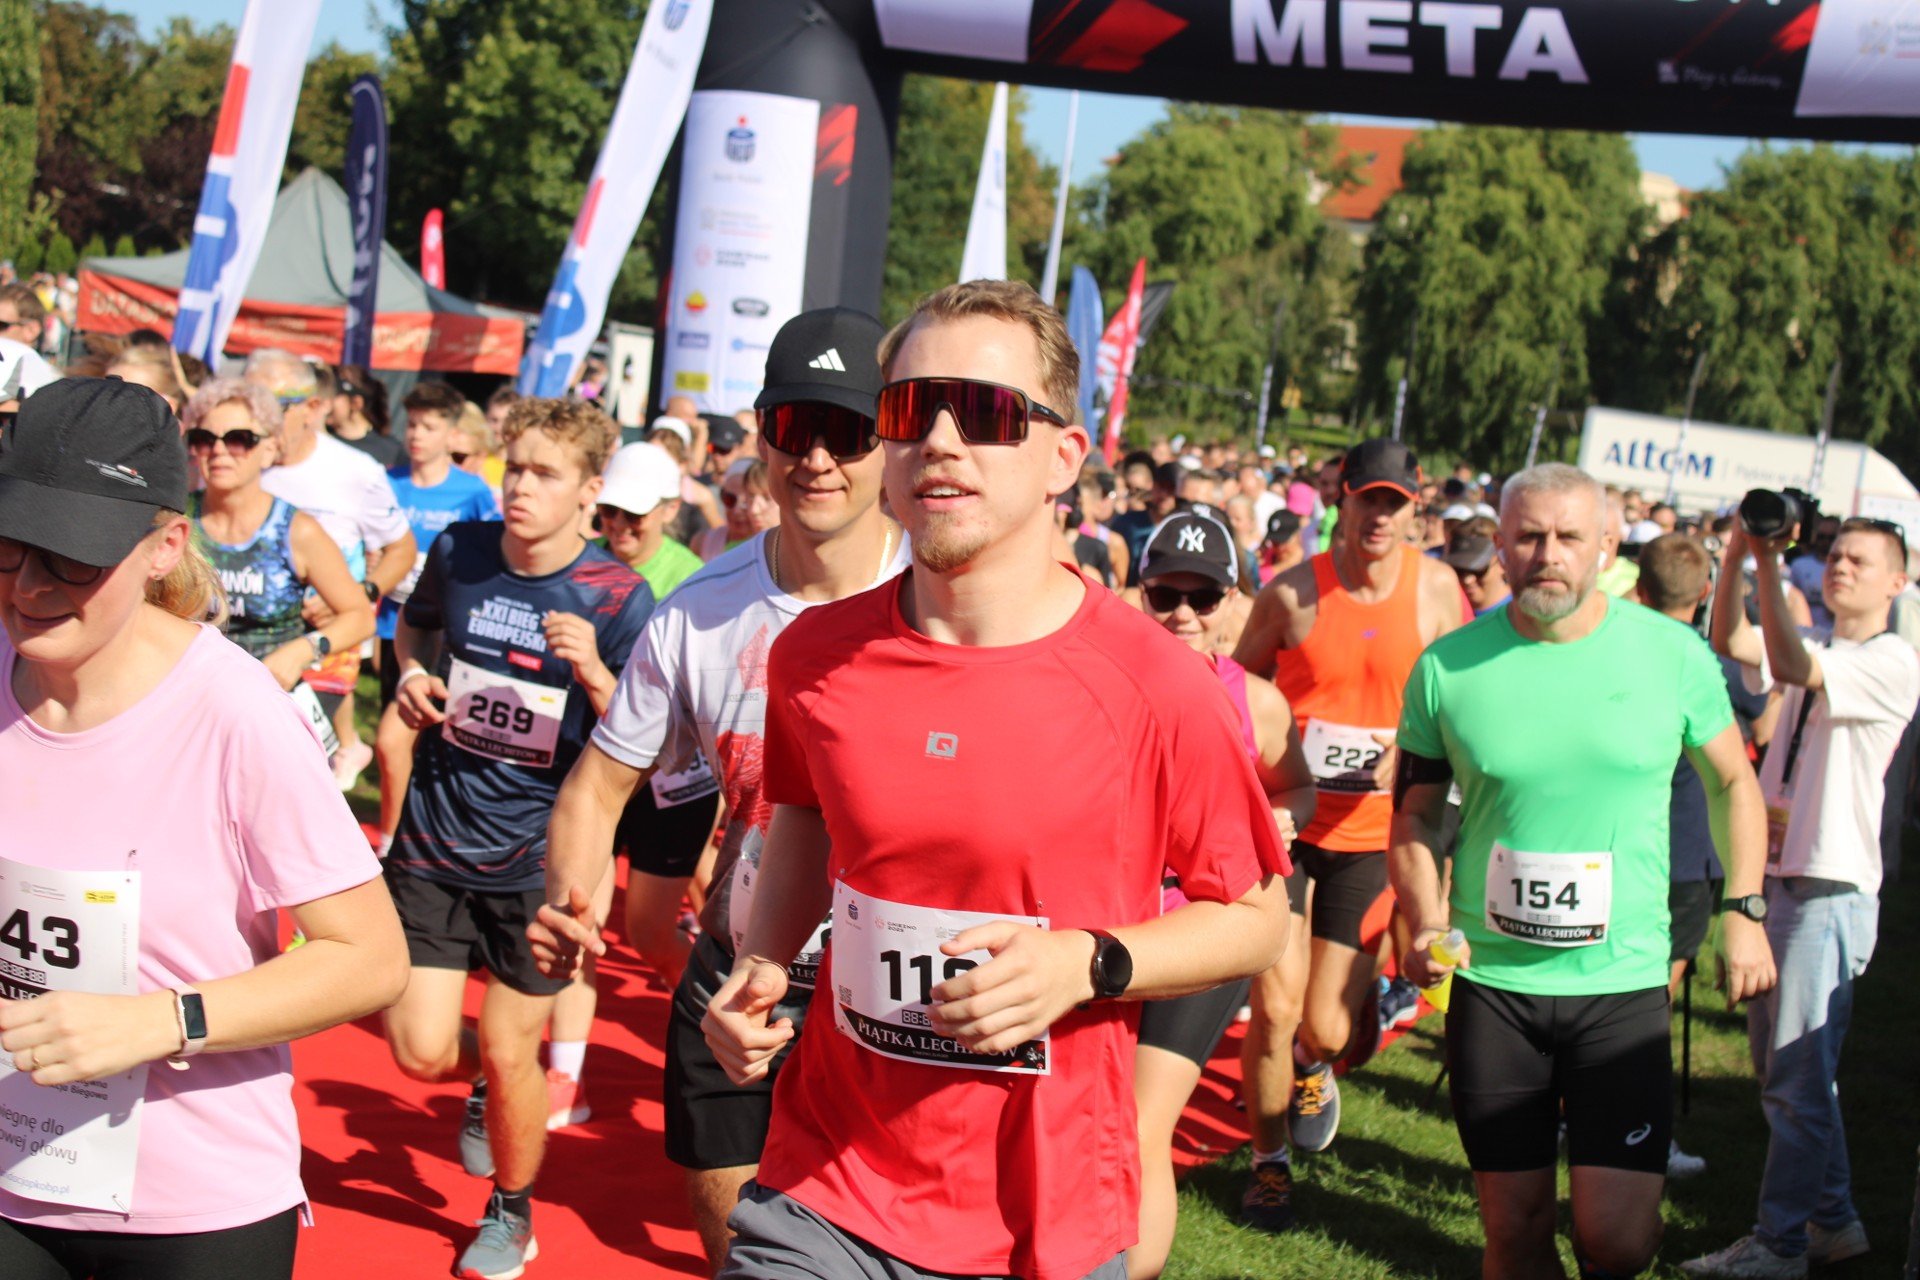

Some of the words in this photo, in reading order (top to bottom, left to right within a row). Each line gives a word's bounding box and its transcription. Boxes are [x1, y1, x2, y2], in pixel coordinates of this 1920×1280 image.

[1229, 0, 1590, 84] META
[507, 608, 541, 631] BIEG
[468, 694, 534, 735] 269
[1325, 746, 1380, 770] 222
[1511, 878, 1580, 911] 154
[858, 1020, 915, 1049] PIĄTKA
[41, 1117, 64, 1136] dla
[30, 1139, 78, 1165] głowy
